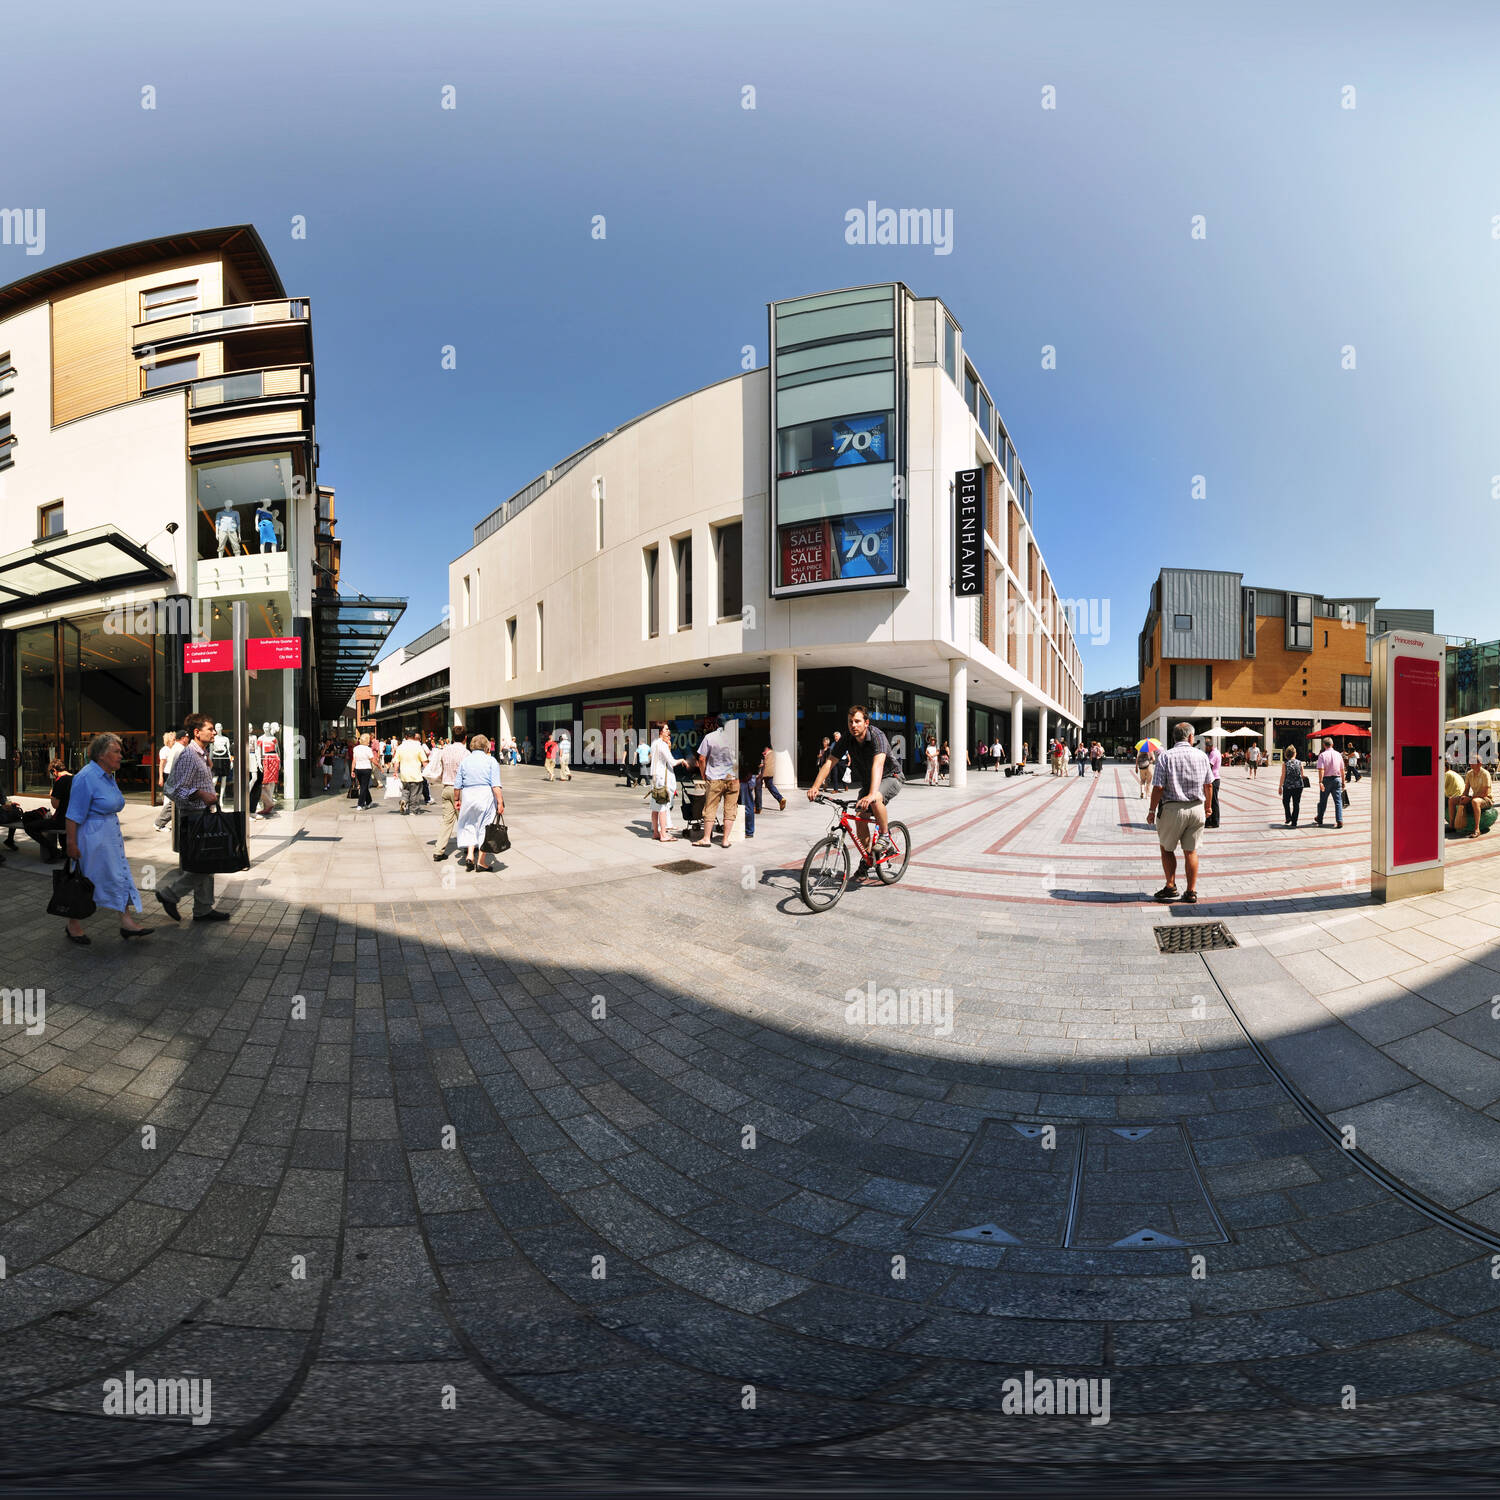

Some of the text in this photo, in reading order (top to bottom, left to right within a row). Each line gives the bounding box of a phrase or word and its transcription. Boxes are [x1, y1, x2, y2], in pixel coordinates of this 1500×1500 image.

[836, 431, 872, 453] 70
[790, 531, 823, 547] SALE
[962, 472, 976, 591] DEBENHAMS
[844, 533, 880, 558] 70
[790, 549, 823, 566] SALE
[790, 569, 823, 585] SALE
[1394, 635, 1425, 648] Princesshay
